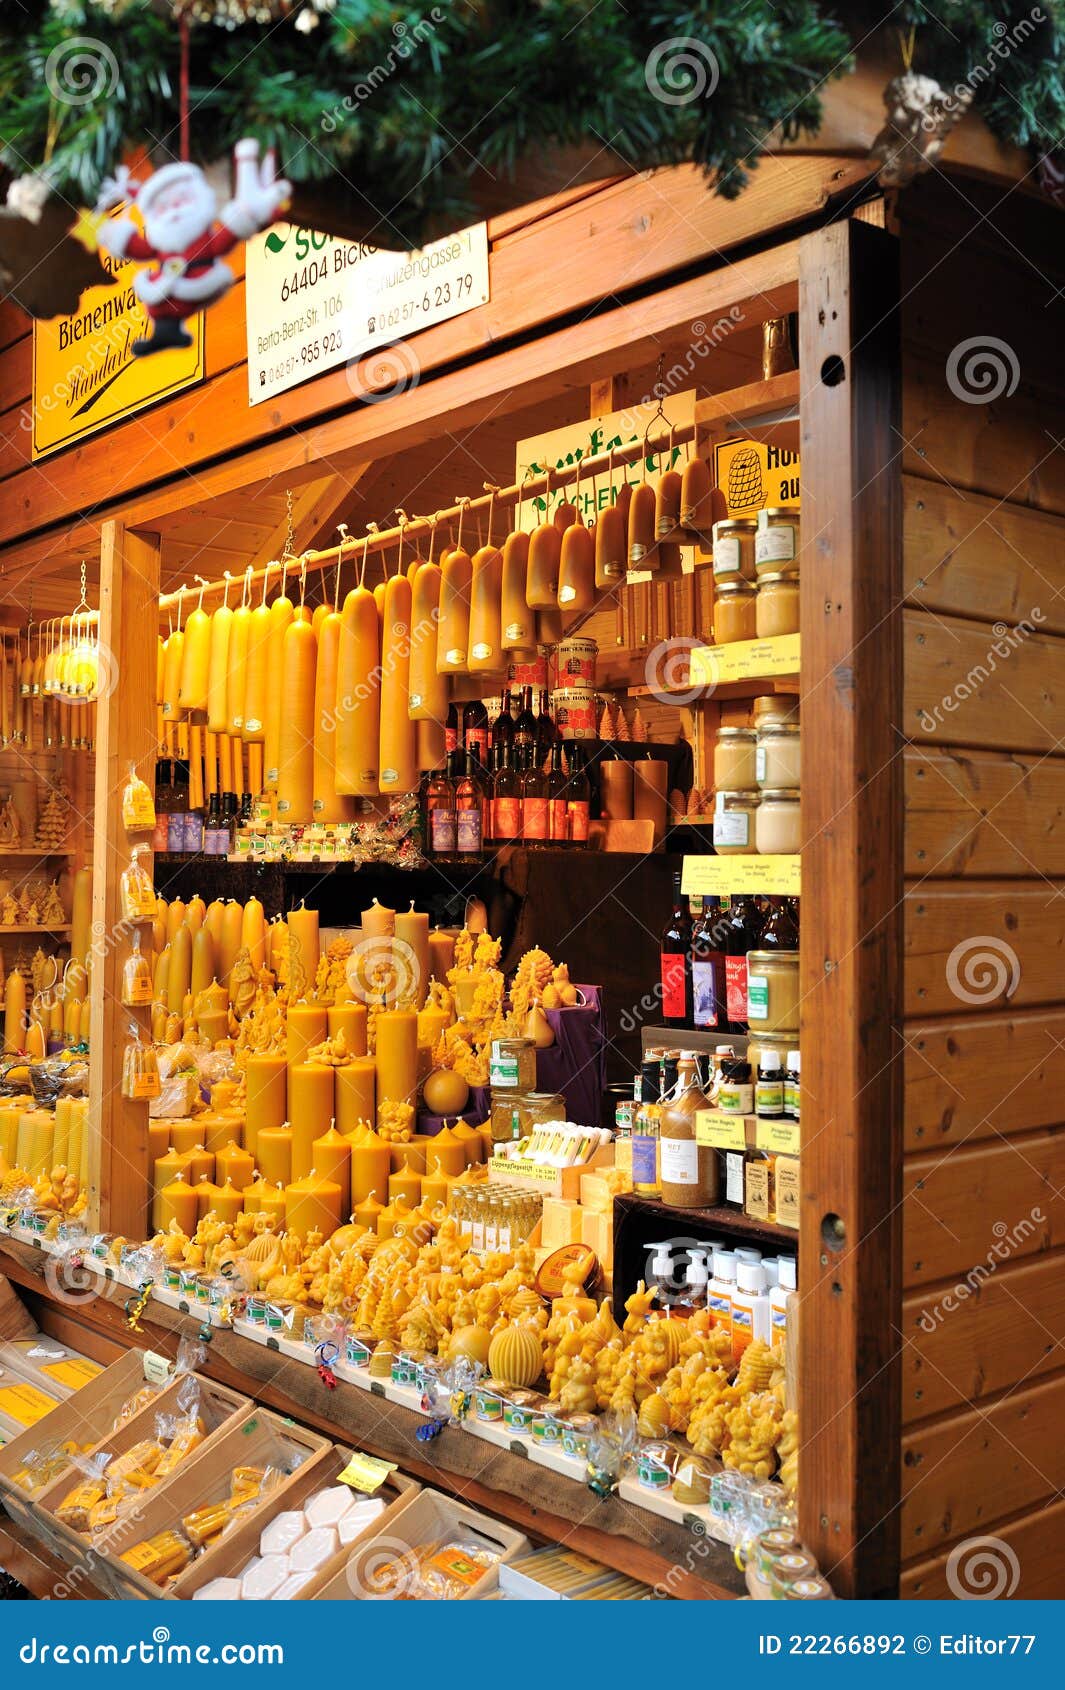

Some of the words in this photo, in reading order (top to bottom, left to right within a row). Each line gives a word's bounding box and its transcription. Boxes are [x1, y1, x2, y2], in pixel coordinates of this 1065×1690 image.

[281, 255, 328, 302] 64404
[58, 287, 137, 351] Bienenwa
[323, 293, 343, 317] 106
